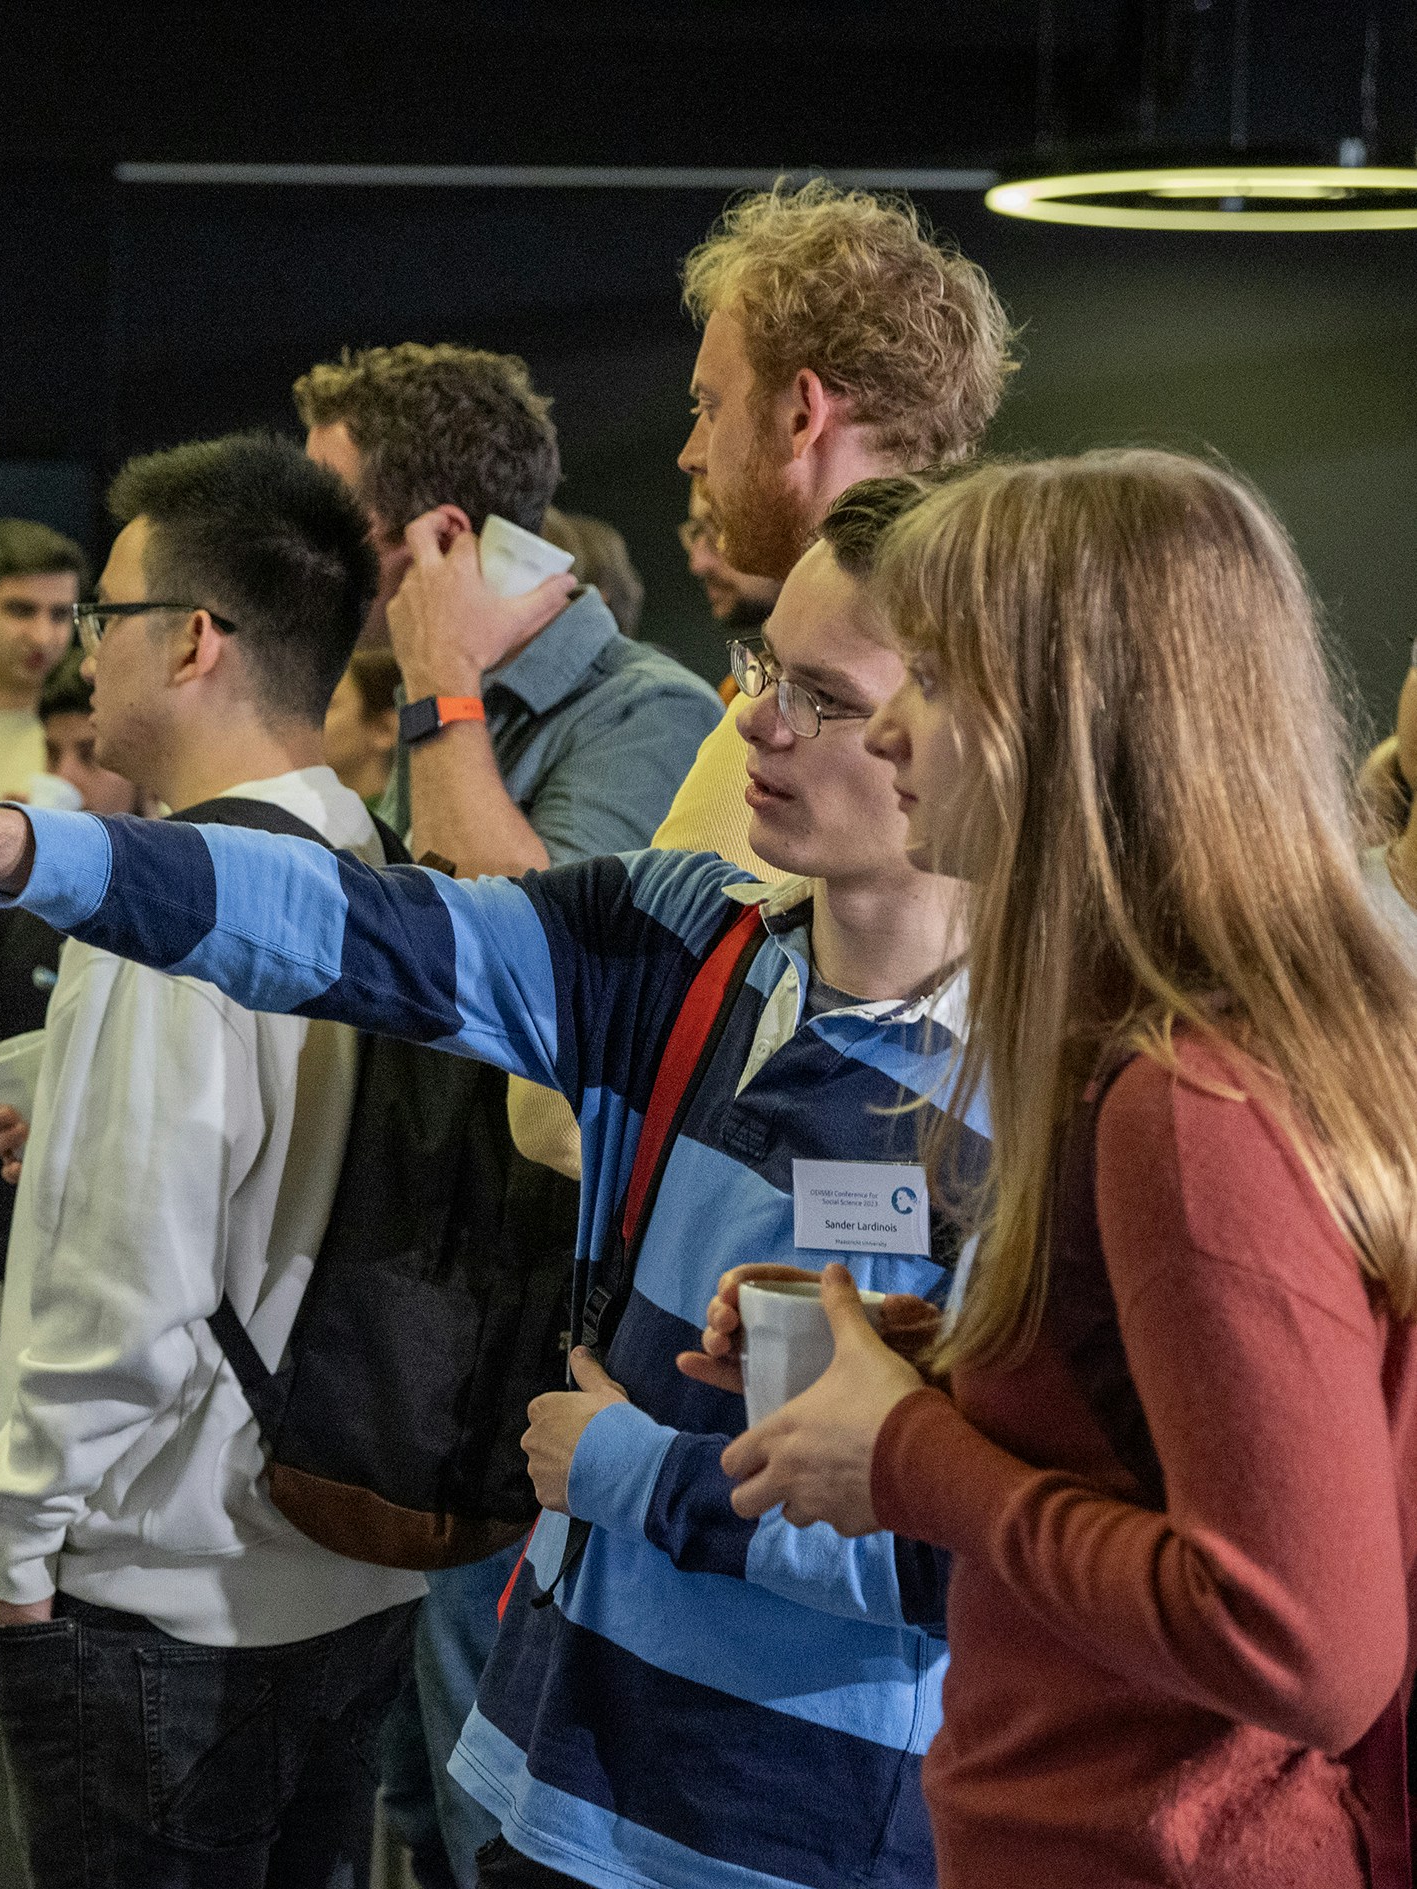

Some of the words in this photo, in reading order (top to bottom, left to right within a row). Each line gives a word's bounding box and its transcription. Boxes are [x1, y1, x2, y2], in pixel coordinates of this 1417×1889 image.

[834, 1190, 868, 1198] Conference
[822, 1198, 840, 1206] Social
[840, 1199, 863, 1207] Science
[825, 1219, 855, 1230] Sander
[857, 1222, 898, 1232] Lardinois
